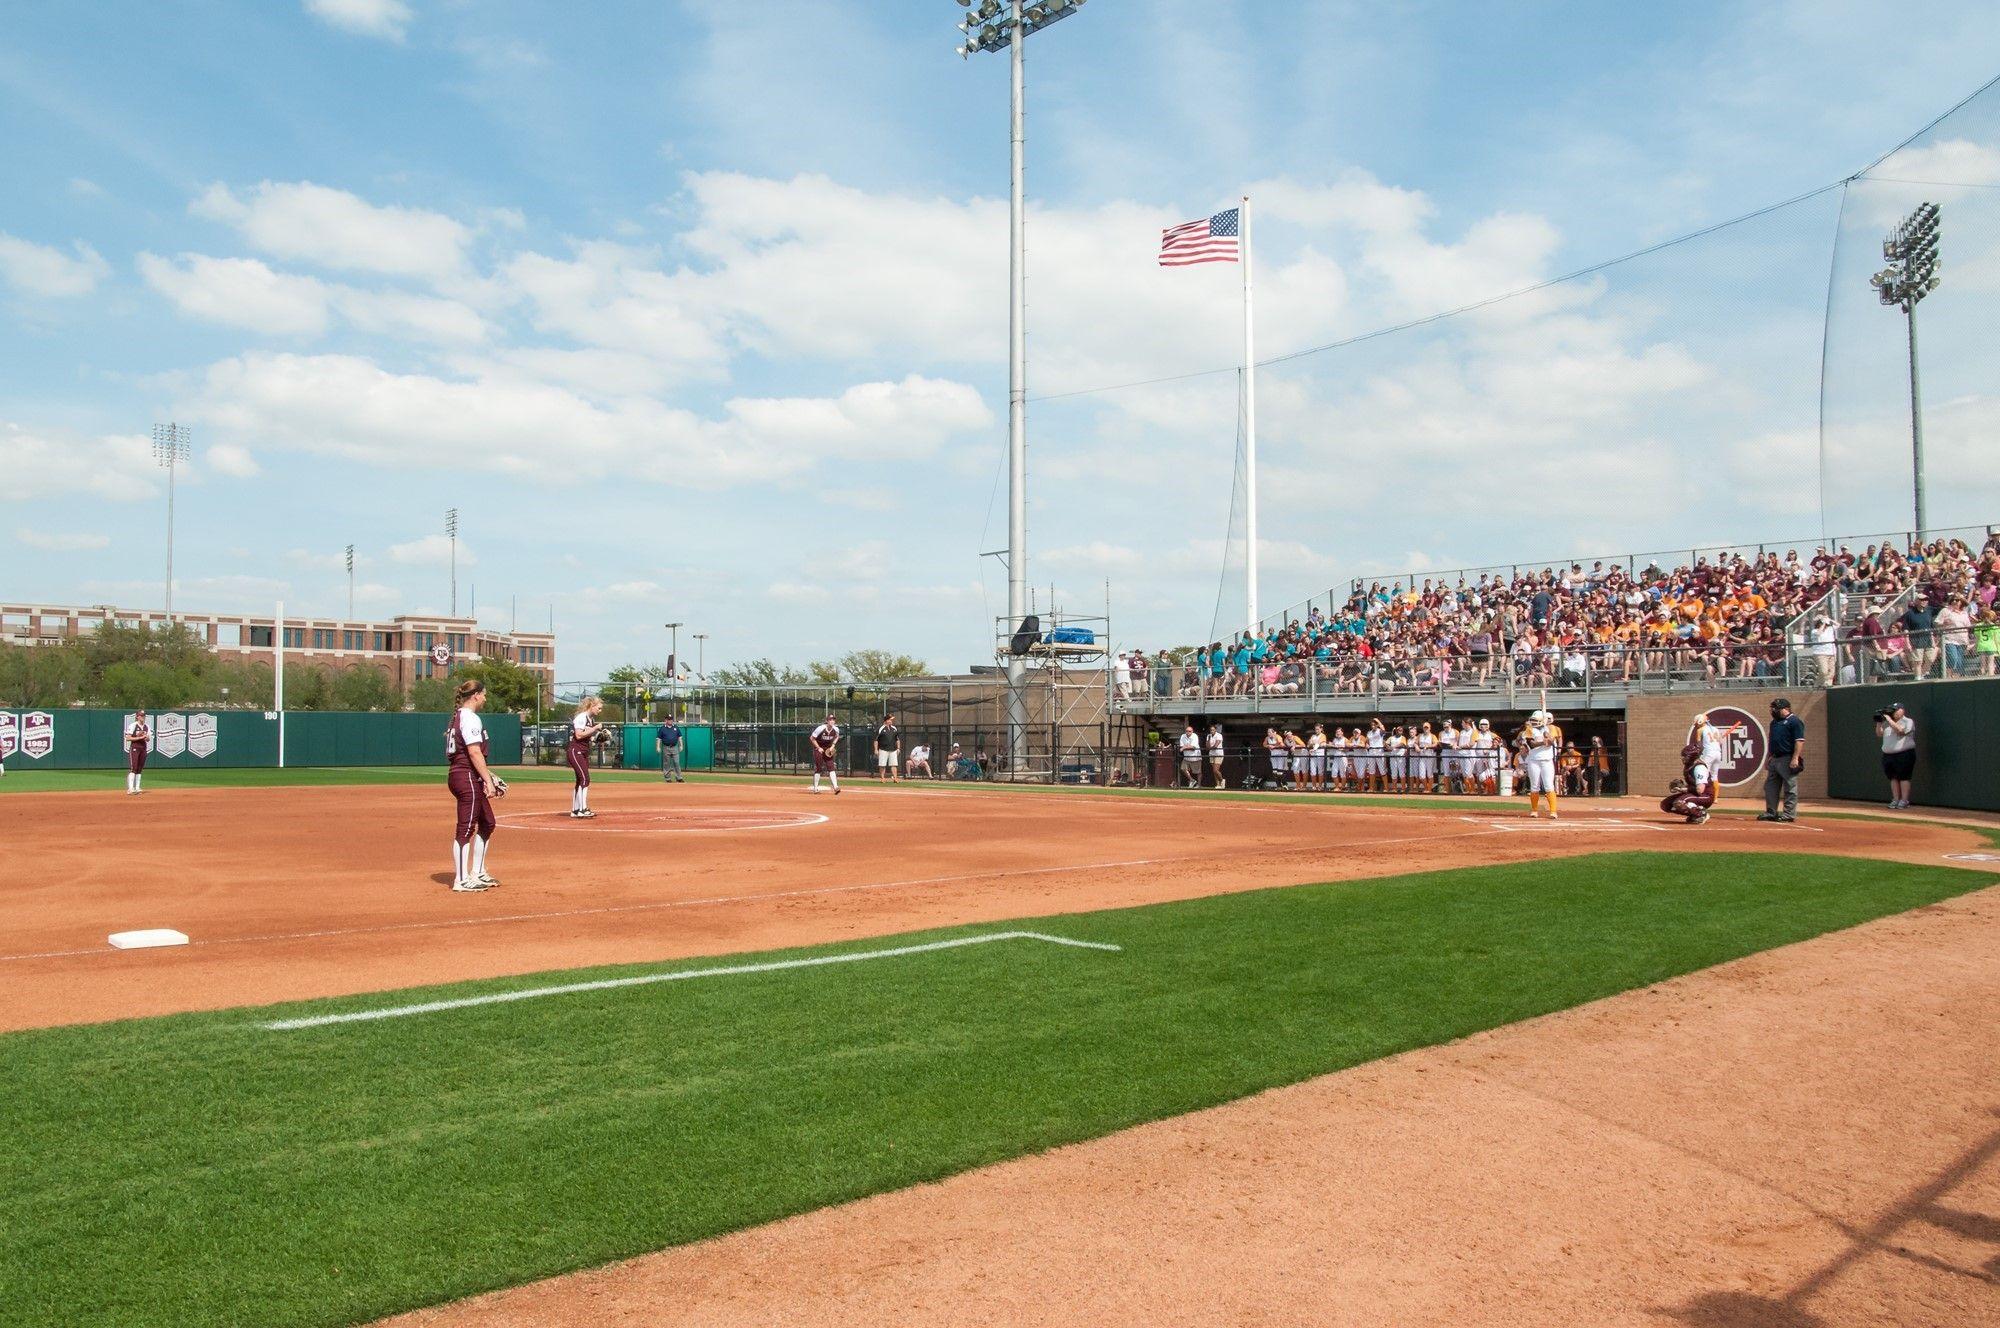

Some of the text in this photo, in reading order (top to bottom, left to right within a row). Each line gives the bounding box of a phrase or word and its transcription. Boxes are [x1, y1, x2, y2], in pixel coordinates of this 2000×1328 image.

[1981, 629, 1989, 641] 5
[264, 711, 278, 720] 190
[27, 740, 48, 748] 1982
